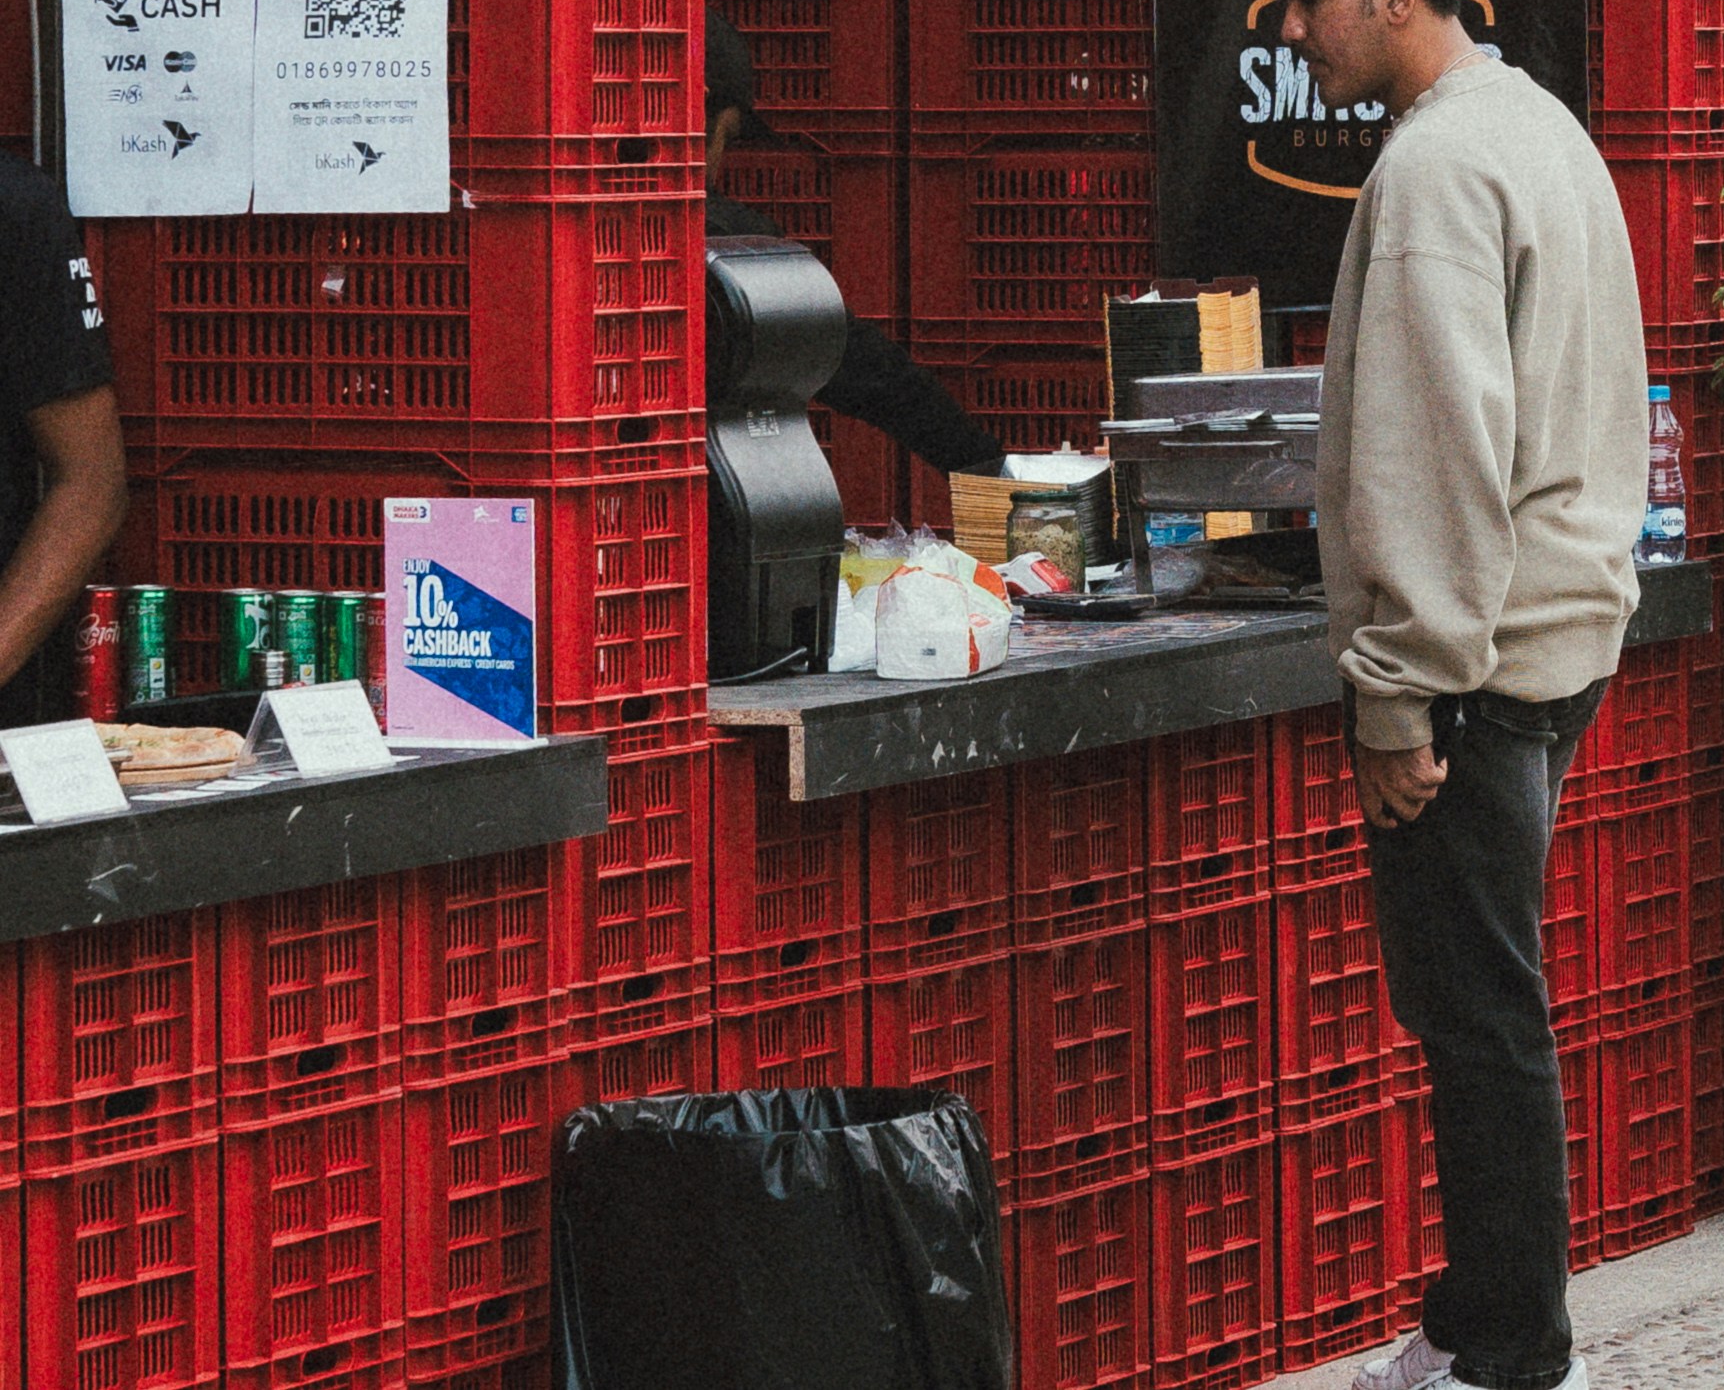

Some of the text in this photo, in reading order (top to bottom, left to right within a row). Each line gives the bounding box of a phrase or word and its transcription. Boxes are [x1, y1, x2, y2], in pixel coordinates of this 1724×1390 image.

[101, 54, 147, 72] VISA
[276, 60, 432, 79] 01869978025
[121, 134, 167, 153] bKash
[315, 153, 355, 169] bKash
[419, 506, 427, 519] 3
[403, 559, 432, 574] ENJOY
[403, 574, 459, 629] 10%
[403, 628, 492, 657] CASHBACK
[418, 658, 447, 668] AMERICAN
[475, 659, 495, 669] CREDIT
[495, 660, 515, 670] CARDS
